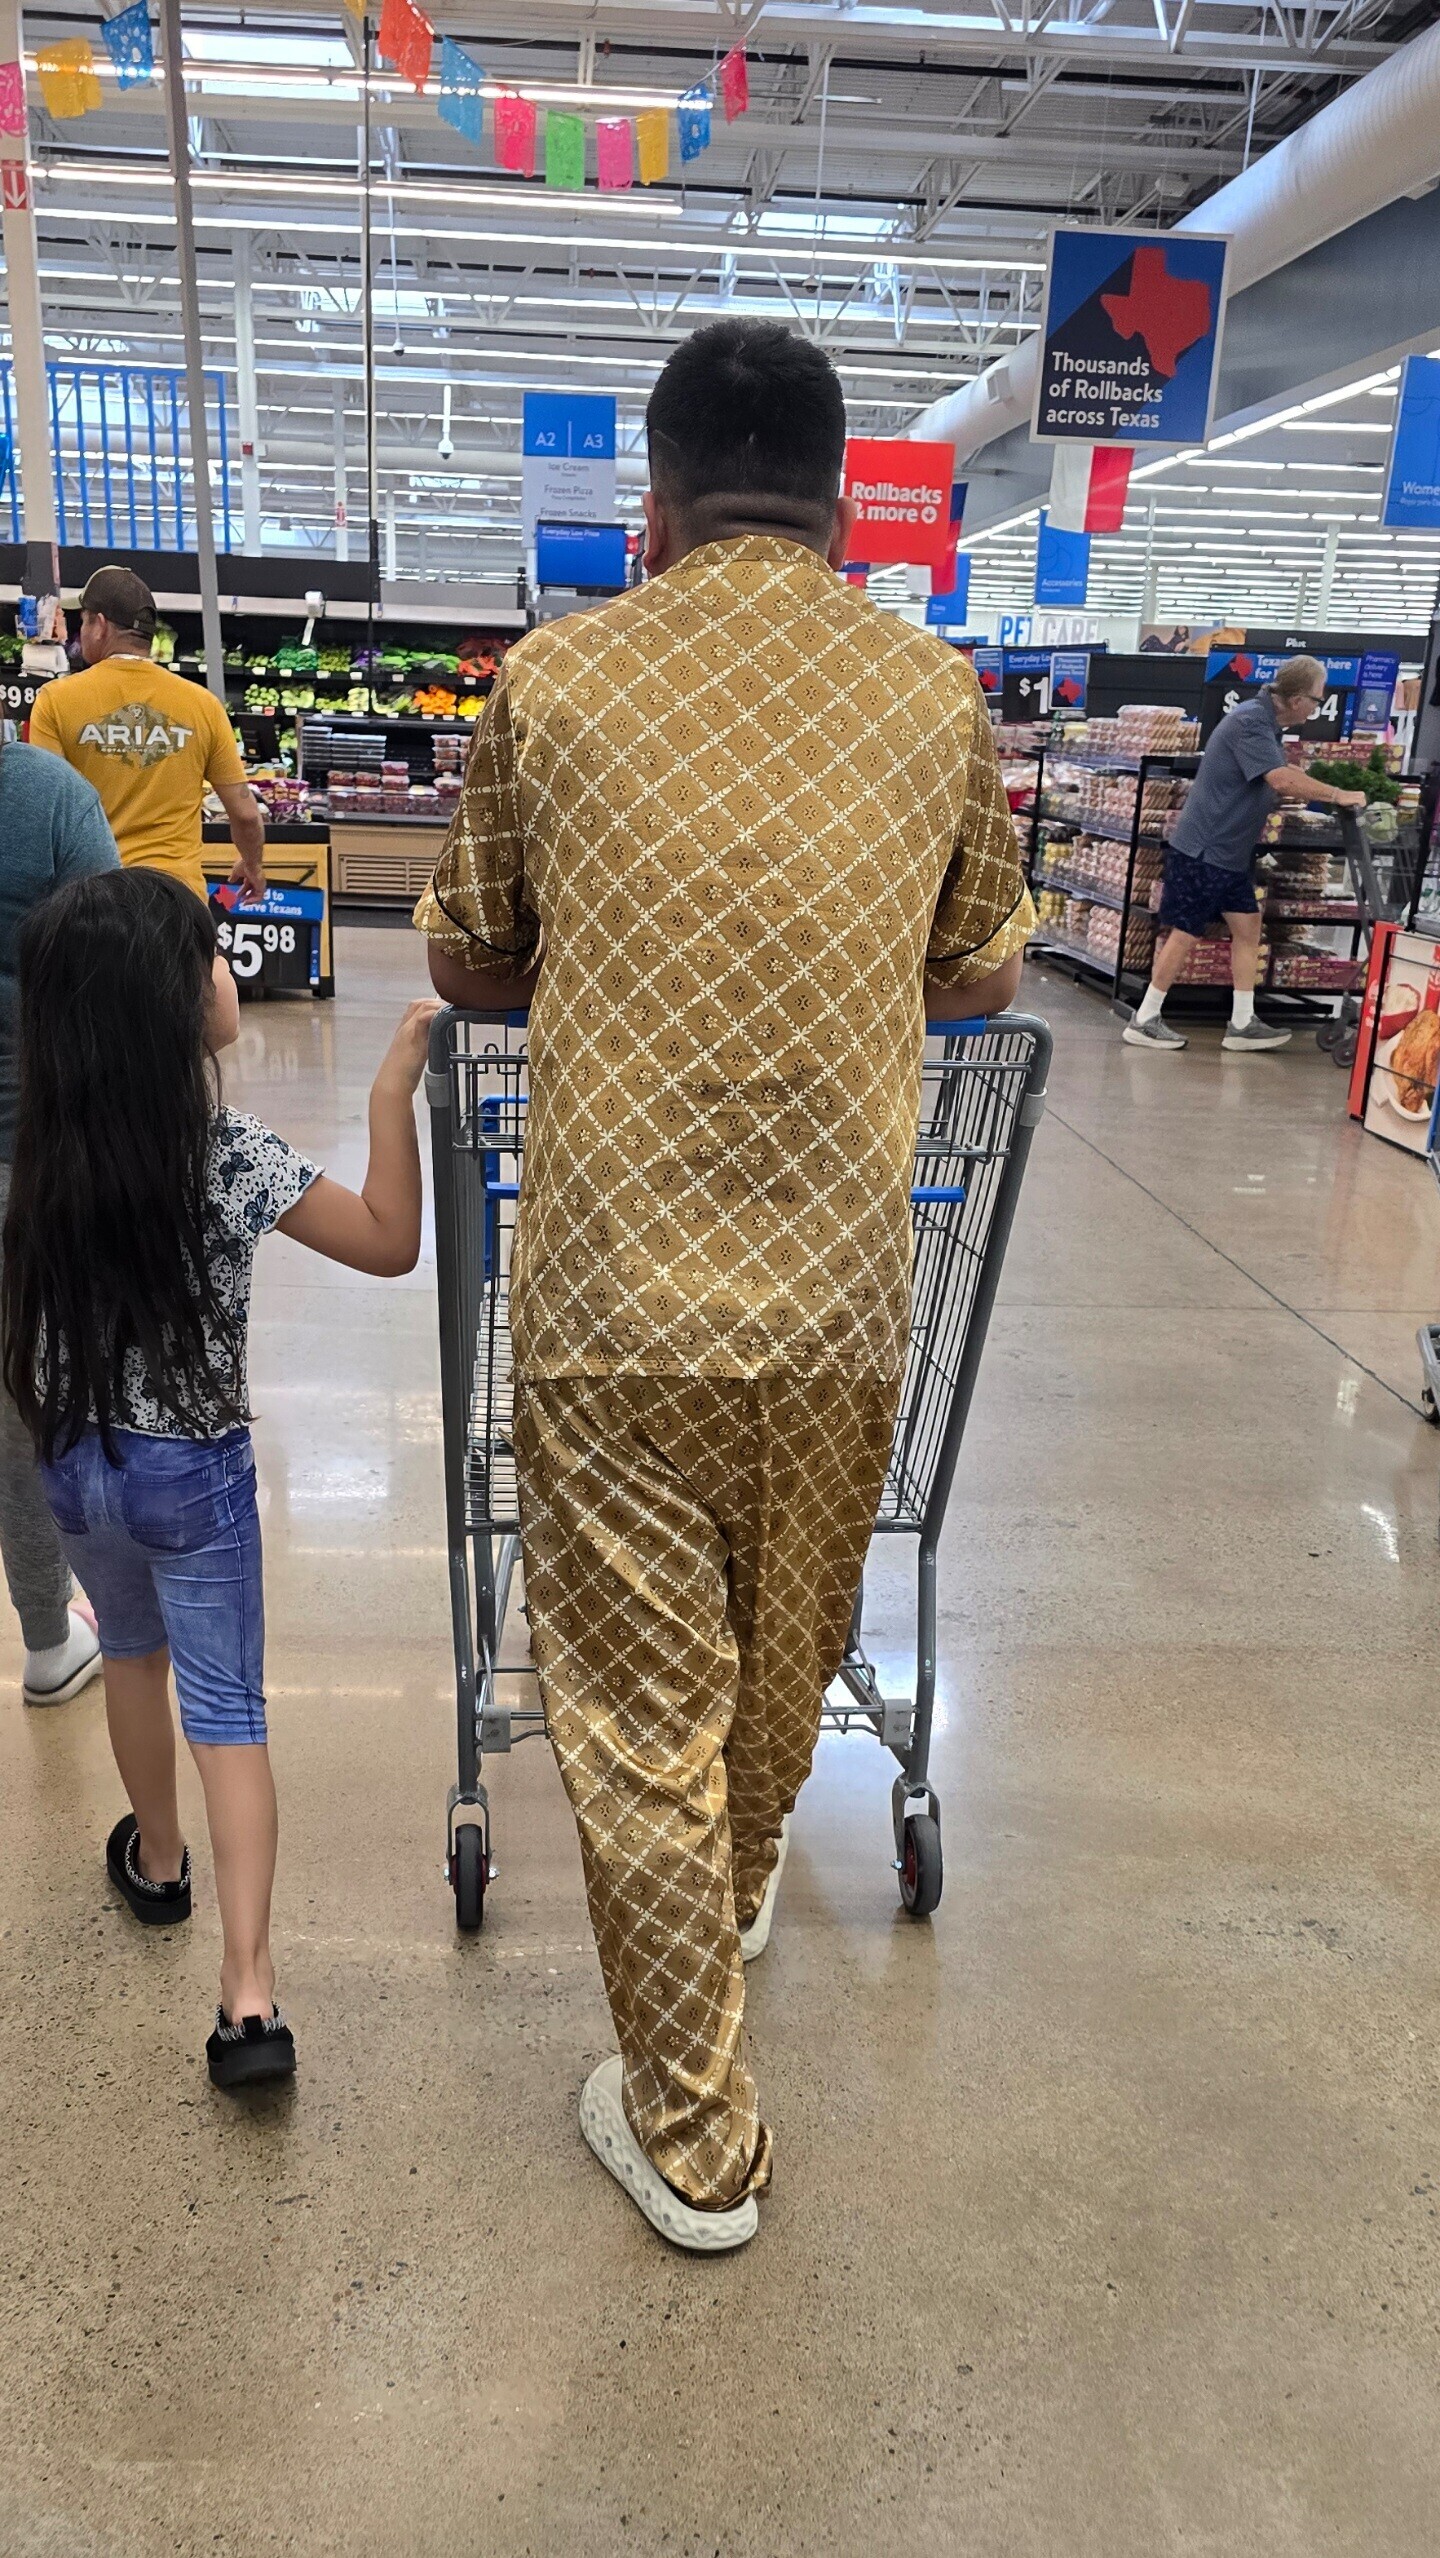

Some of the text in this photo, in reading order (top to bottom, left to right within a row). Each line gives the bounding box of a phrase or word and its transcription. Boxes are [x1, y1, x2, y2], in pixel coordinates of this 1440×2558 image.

[1052, 351, 1149, 376] Thousands
[1049, 378, 1163, 403] of Rollbacks
[1046, 406, 1160, 428] across Texas
[535, 432, 556, 447] A2
[583, 434, 604, 449] A3
[562, 462, 590, 471] Cream
[544, 484, 593, 496] Frozen Pizza
[851, 481, 943, 504] Rollbacks
[867, 505, 918, 523] more
[1327, 657, 1352, 670] here
[1255, 667, 1272, 679] for
[79, 723, 193, 748] ARIAT
[272, 890, 285, 901] to
[268, 901, 302, 916] Texans
